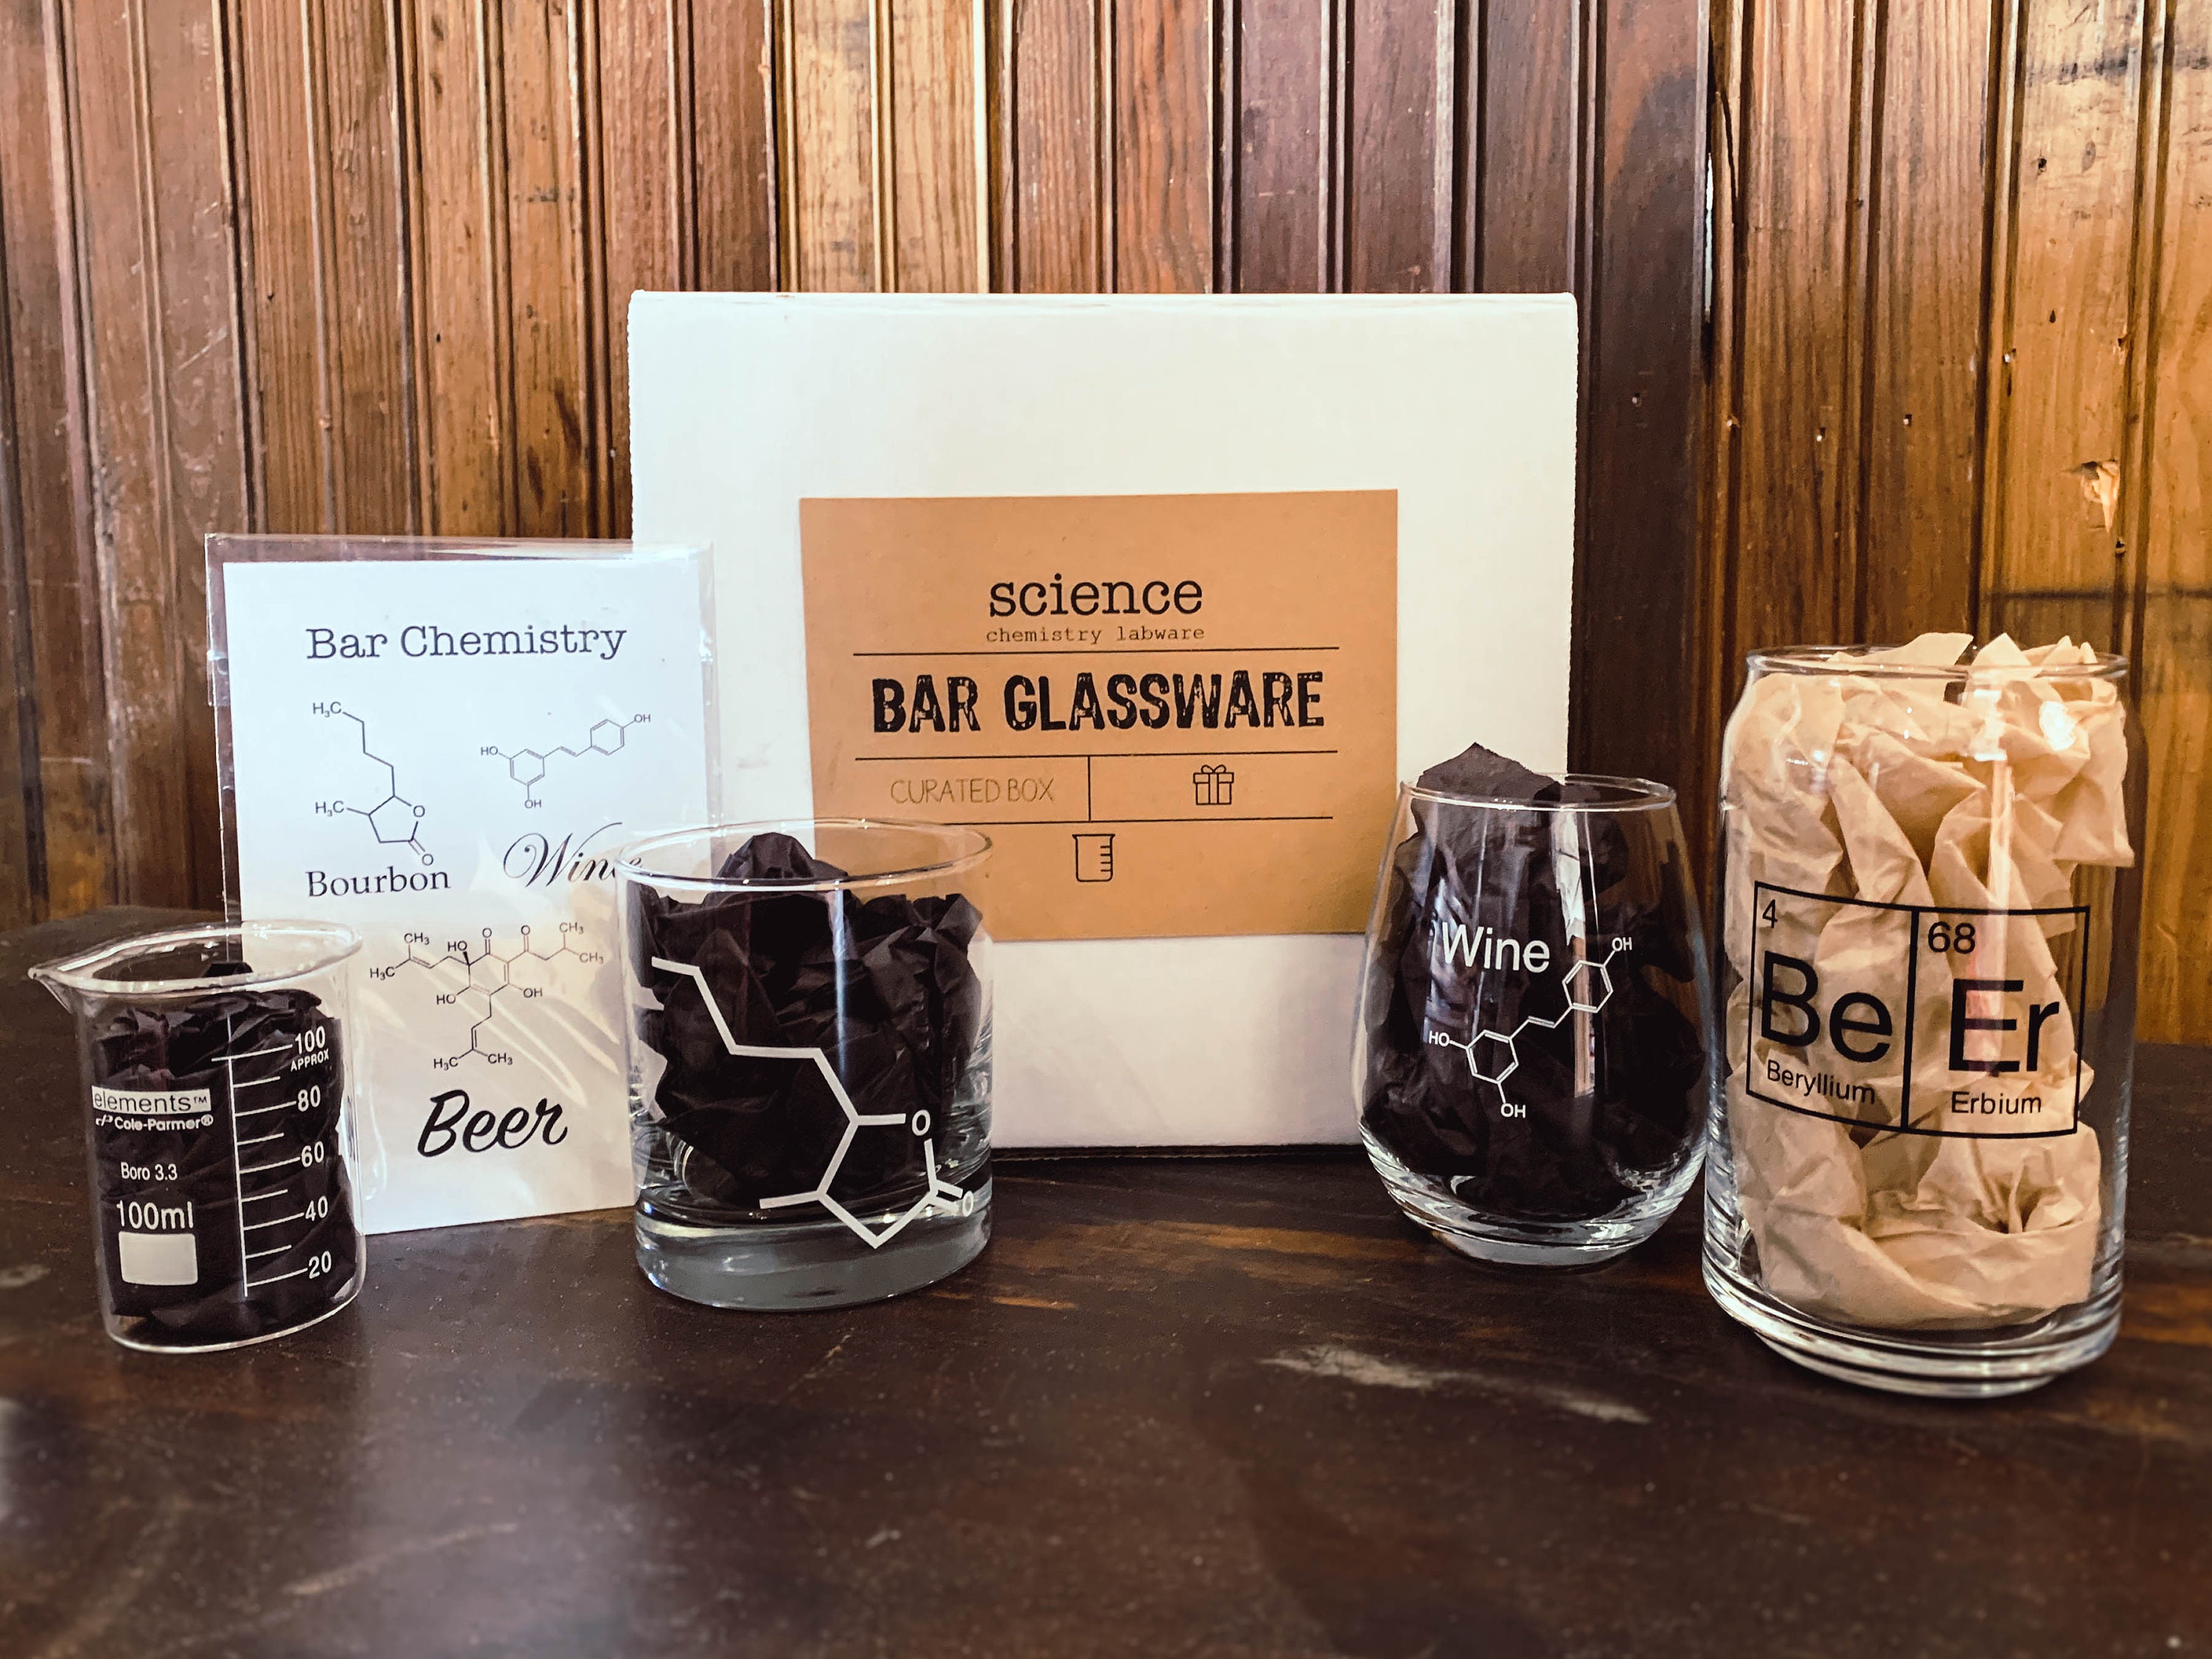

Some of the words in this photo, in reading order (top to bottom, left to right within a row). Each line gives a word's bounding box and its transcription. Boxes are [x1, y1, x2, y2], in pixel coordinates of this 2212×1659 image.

[989, 573, 1203, 618] science
[305, 627, 389, 660] Bar
[400, 625, 627, 661] Chemistry
[986, 625, 1102, 645] chemistry
[1116, 625, 1206, 641] labware
[872, 674, 981, 734] BAR
[1004, 670, 1325, 731] GLASSWARE
[633, 714, 651, 723] OH
[480, 746, 498, 756] HO
[890, 778, 1001, 805] CURATED
[1008, 777, 1054, 802] BOX
[413, 805, 425, 817] O
[524, 799, 542, 810] OH
[421, 855, 434, 866] O
[305, 866, 451, 897] Bourbon
[1761, 899, 1778, 929] 4
[448, 940, 467, 952] HO
[1441, 922, 1550, 973] Wine
[1612, 936, 1632, 952] OH
[1927, 921, 1976, 954] 68
[436, 993, 456, 1006] HO
[523, 987, 543, 998] OH
[1760, 950, 1893, 1063] Be
[1949, 978, 2060, 1073] Er
[295, 1026, 326, 1055] 100
[1428, 1031, 1450, 1047] HO
[291, 1048, 330, 1072] APPROX
[1767, 1060, 1877, 1105] Beryllium
[297, 1085, 321, 1112] 80
[1500, 1103, 1526, 1119] OH
[1951, 1091, 2042, 1115] Erbium
[417, 1089, 568, 1158] Beer
[911, 1110, 931, 1136] O
[301, 1141, 324, 1167] 60
[120, 1161, 150, 1180] Boro
[154, 1163, 178, 1181] 3.3
[116, 1200, 194, 1230] 100ml
[305, 1196, 328, 1222] 40
[308, 1251, 332, 1279] 20
